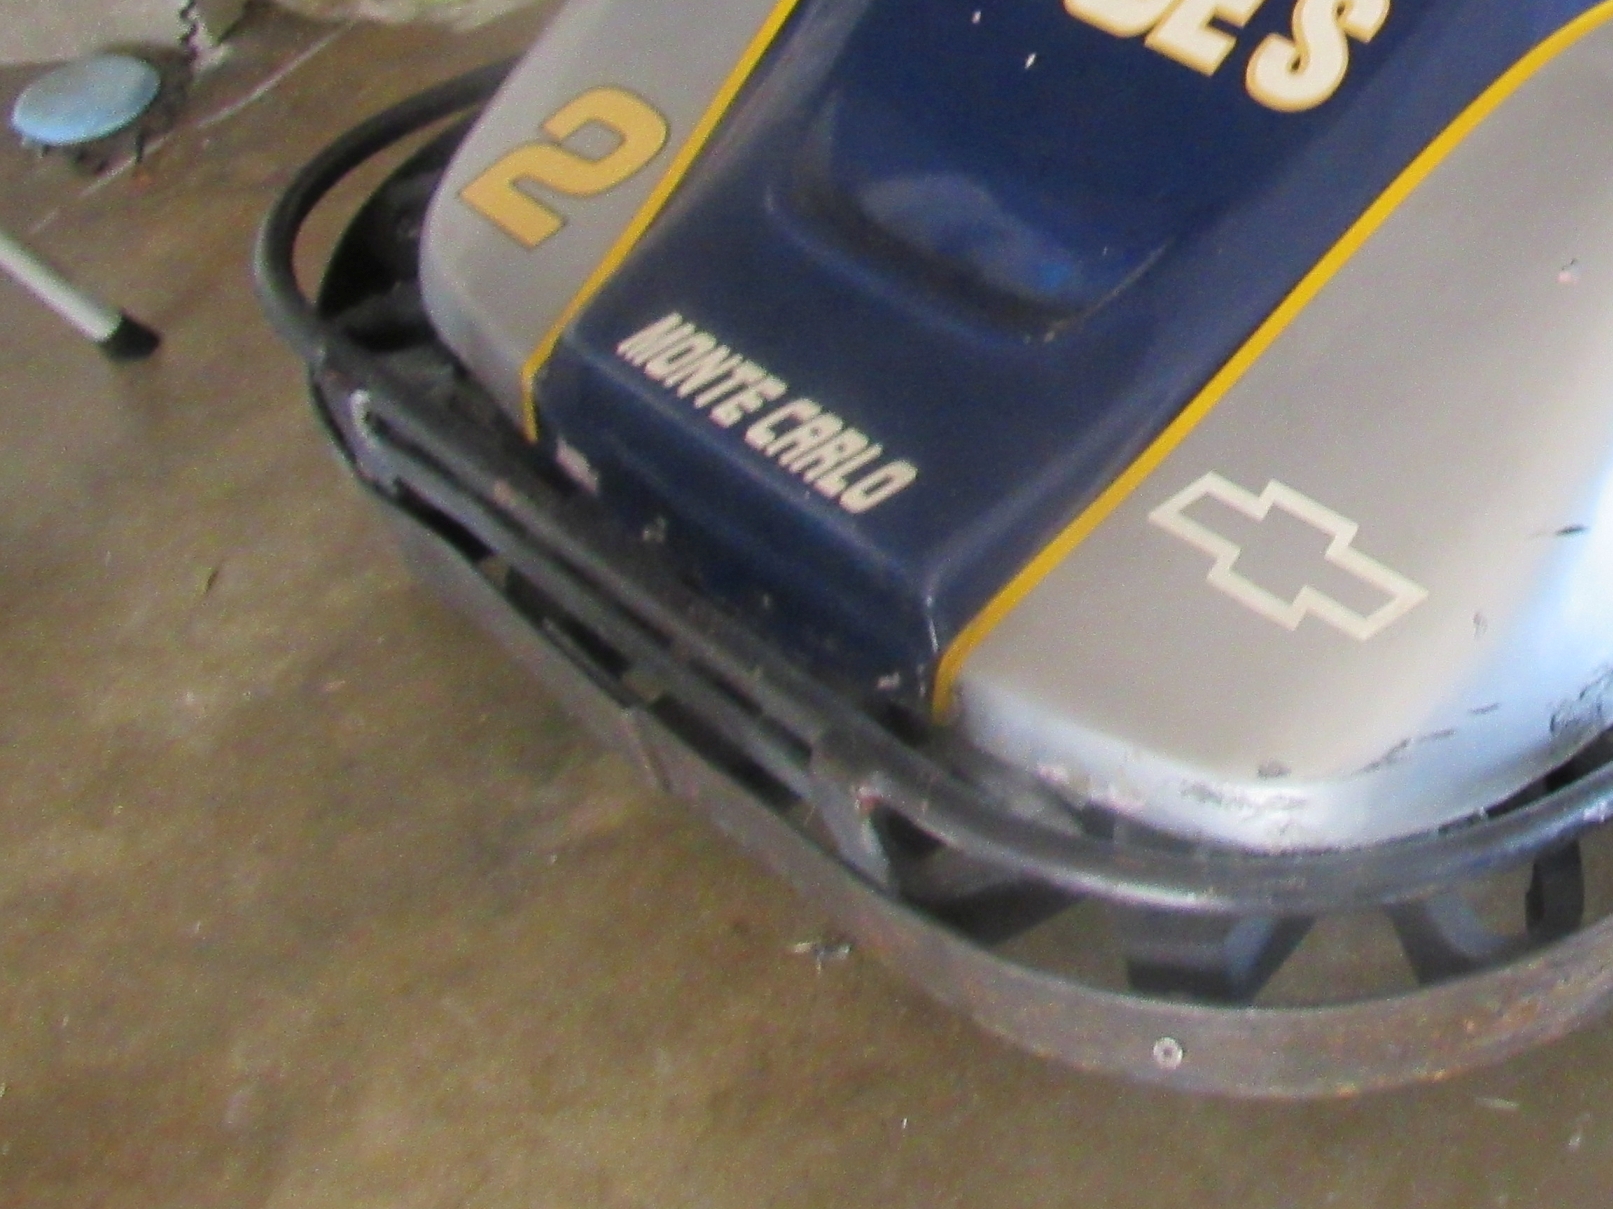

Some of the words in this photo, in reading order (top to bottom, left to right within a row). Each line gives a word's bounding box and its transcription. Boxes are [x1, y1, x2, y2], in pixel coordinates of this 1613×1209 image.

[457, 85, 671, 251] 2
[616, 312, 789, 429] MONTE
[745, 398, 918, 514] CARLO
